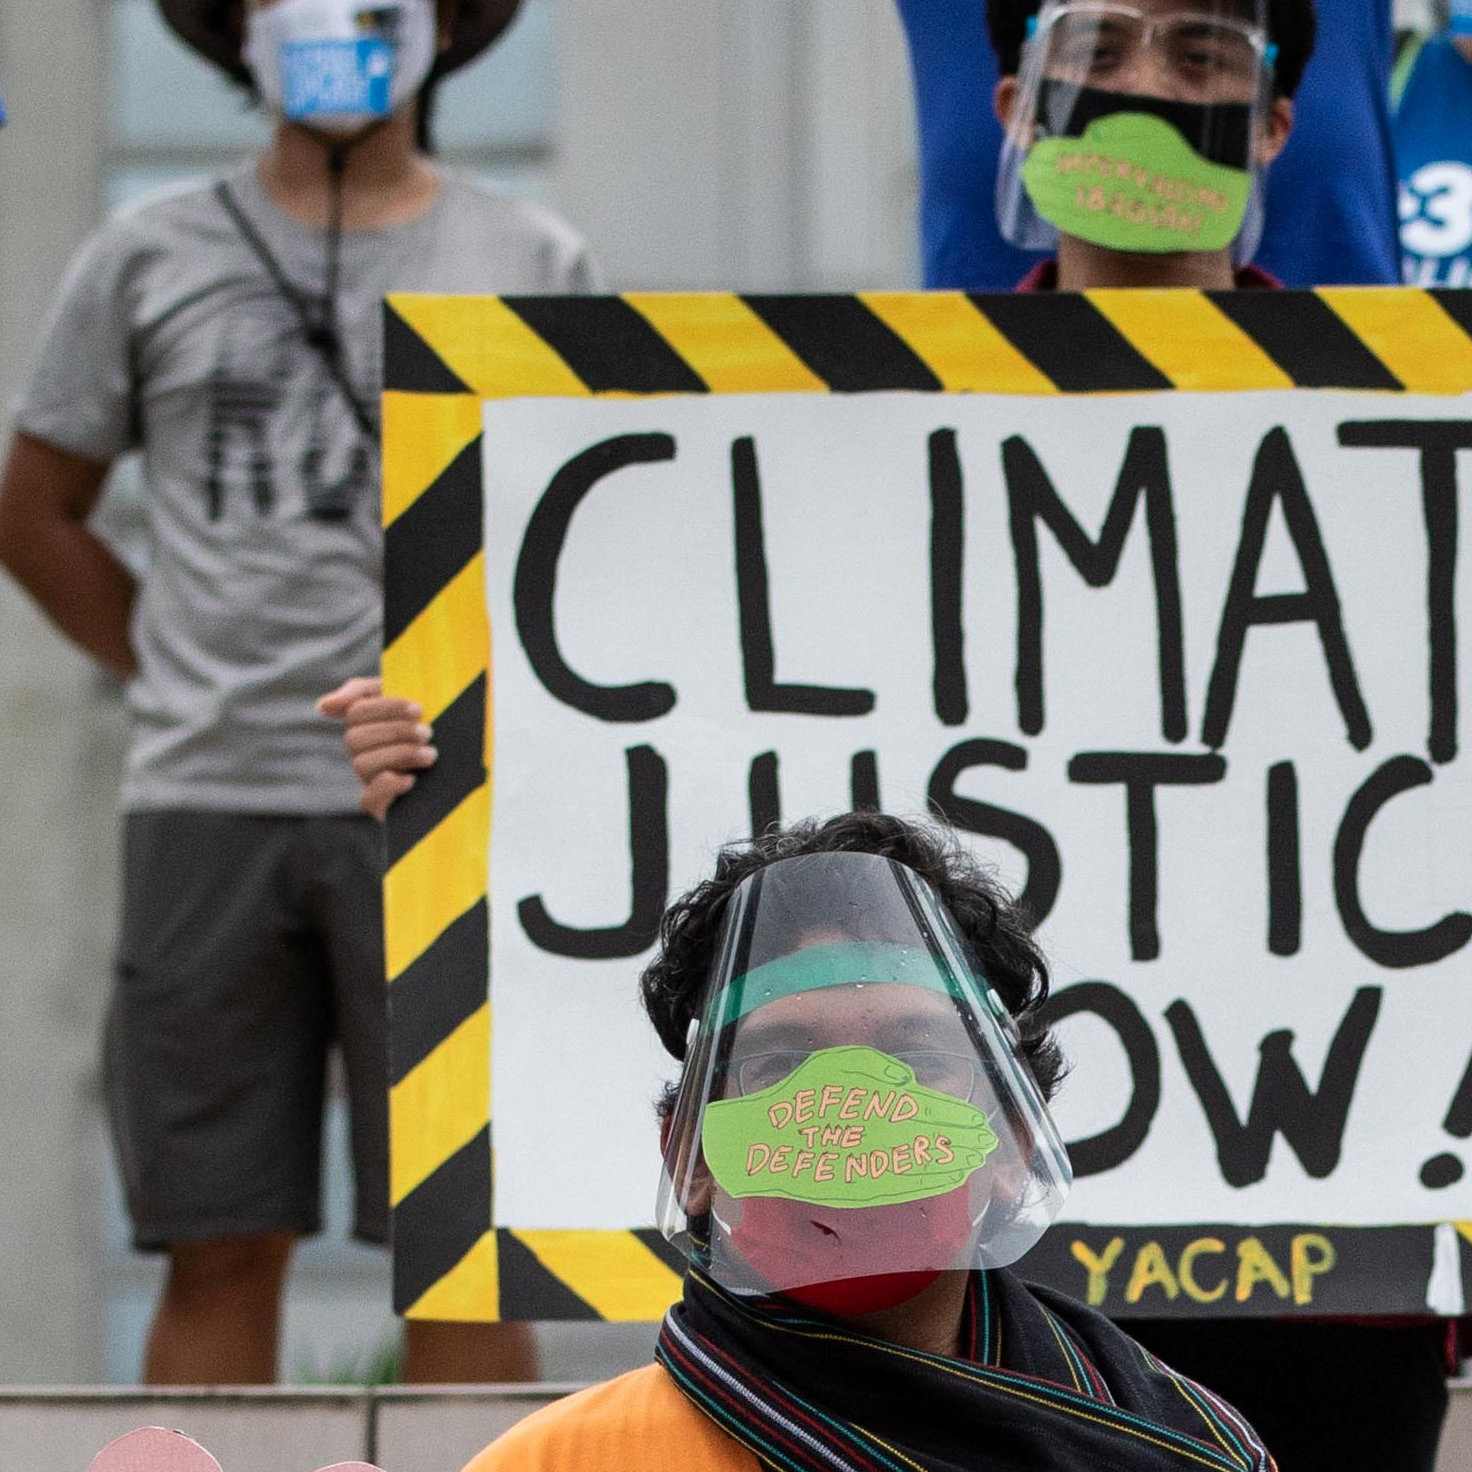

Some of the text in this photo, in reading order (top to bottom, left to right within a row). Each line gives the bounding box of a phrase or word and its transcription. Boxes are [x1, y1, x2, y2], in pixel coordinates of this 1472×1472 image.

[768, 1085, 919, 1129] DEFEND
[746, 1134, 955, 1183] DEFENDERS
[799, 1126, 865, 1149] THE
[1074, 1232, 1336, 1305] YACAP
